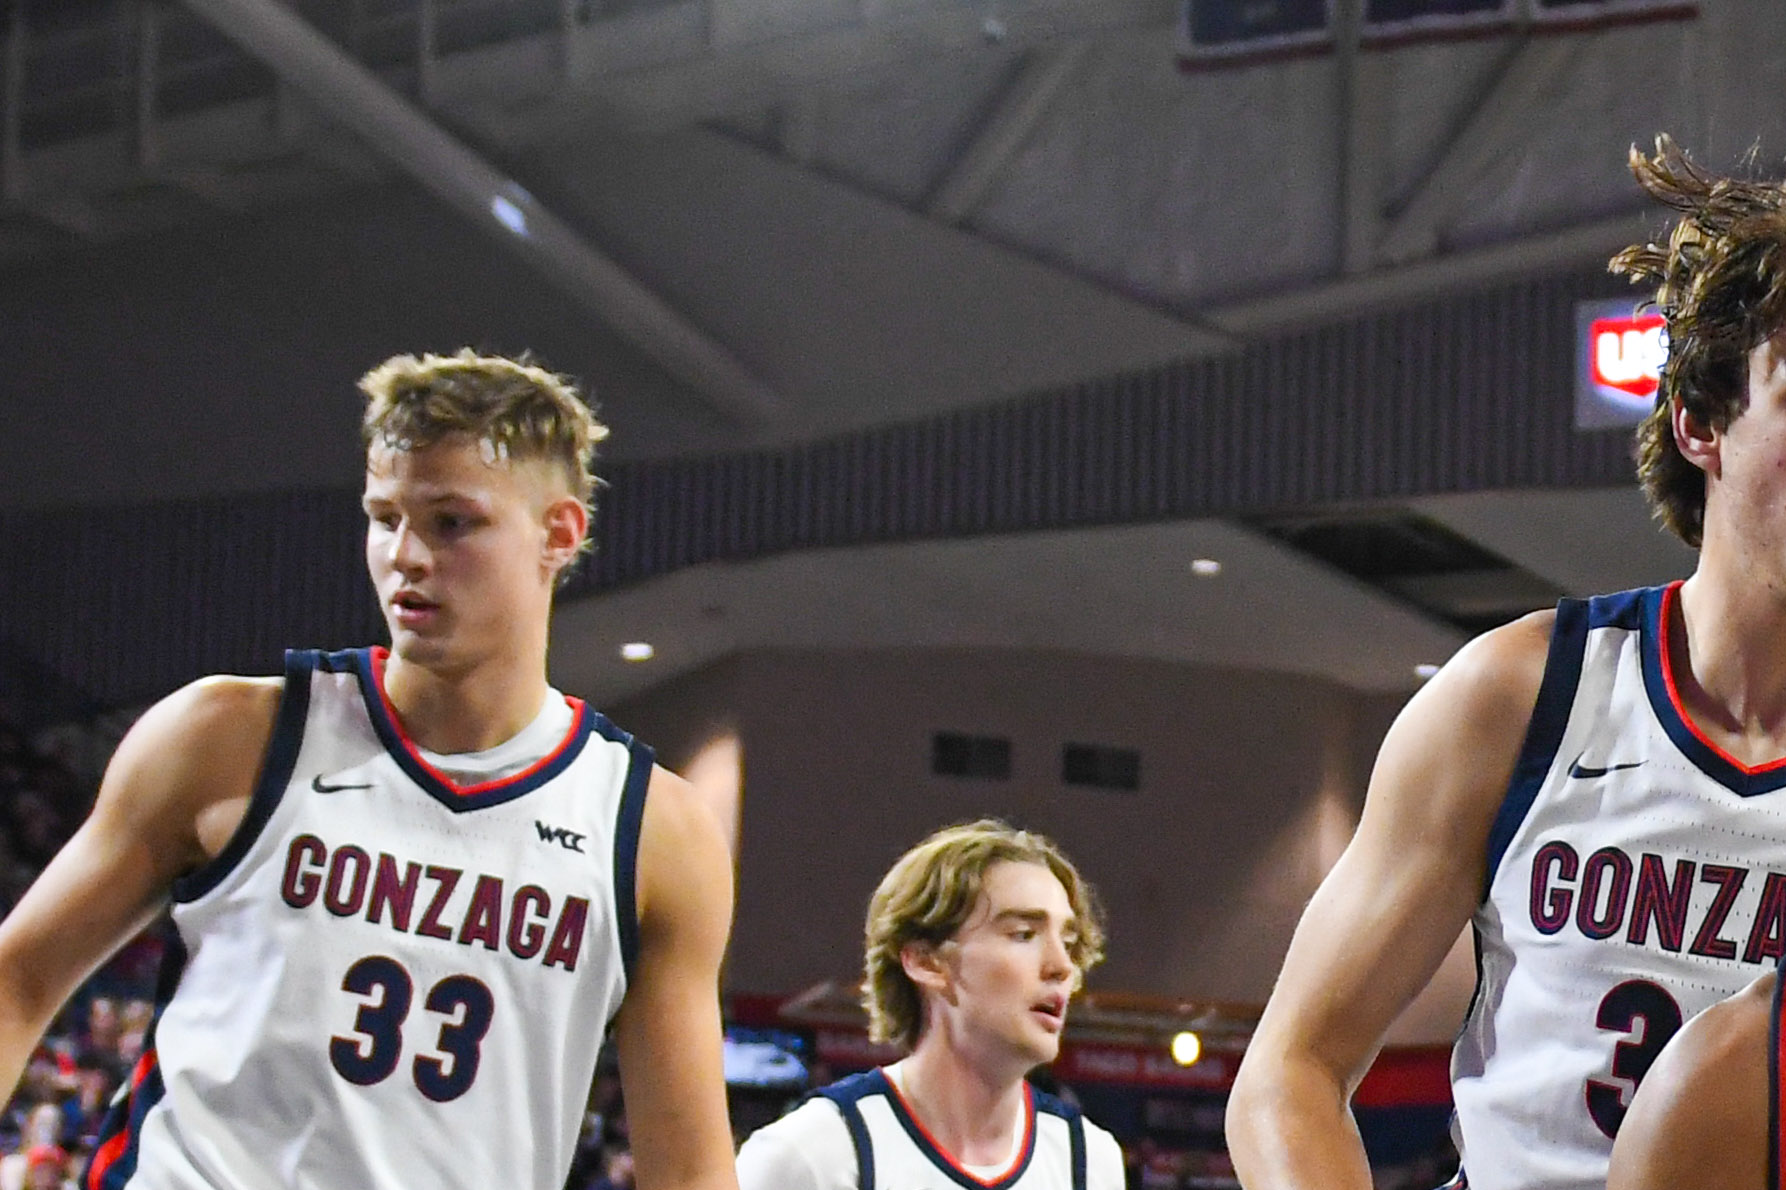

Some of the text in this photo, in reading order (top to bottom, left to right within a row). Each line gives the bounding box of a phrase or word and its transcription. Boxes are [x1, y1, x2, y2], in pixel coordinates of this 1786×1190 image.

[281, 834, 590, 971] GONZAGA
[535, 820, 586, 854] WCC
[330, 955, 495, 1103] 33
